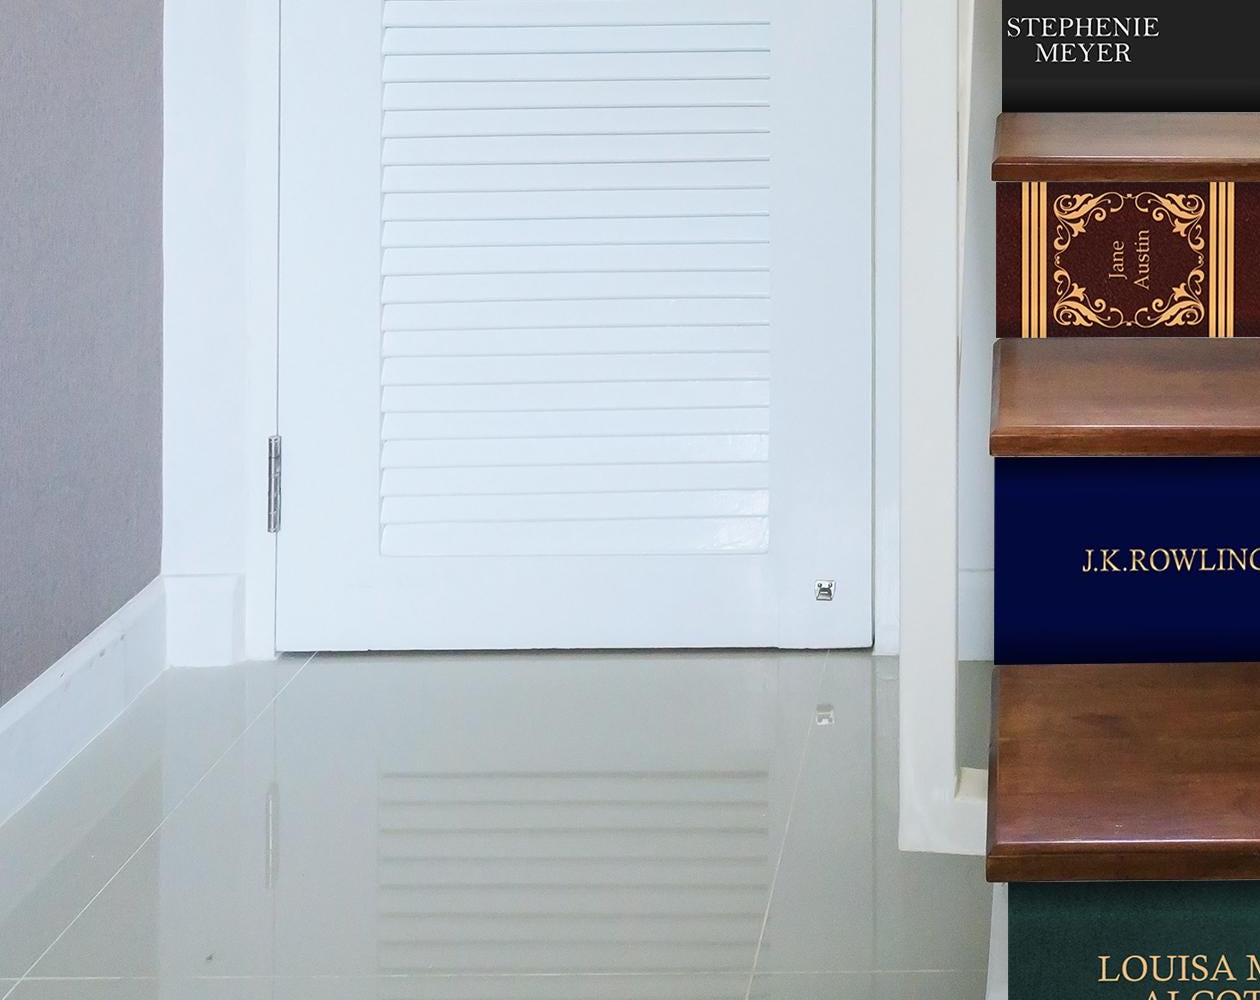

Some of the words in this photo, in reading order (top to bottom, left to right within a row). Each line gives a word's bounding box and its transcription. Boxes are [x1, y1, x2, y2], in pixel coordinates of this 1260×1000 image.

[1008, 18, 1159, 36] STEPHENIE
[1036, 43, 1130, 62] MEYER
[1109, 241, 1127, 279] Jane
[1134, 231, 1149, 289] Austin
[1098, 955, 1236, 981] LOUISA
